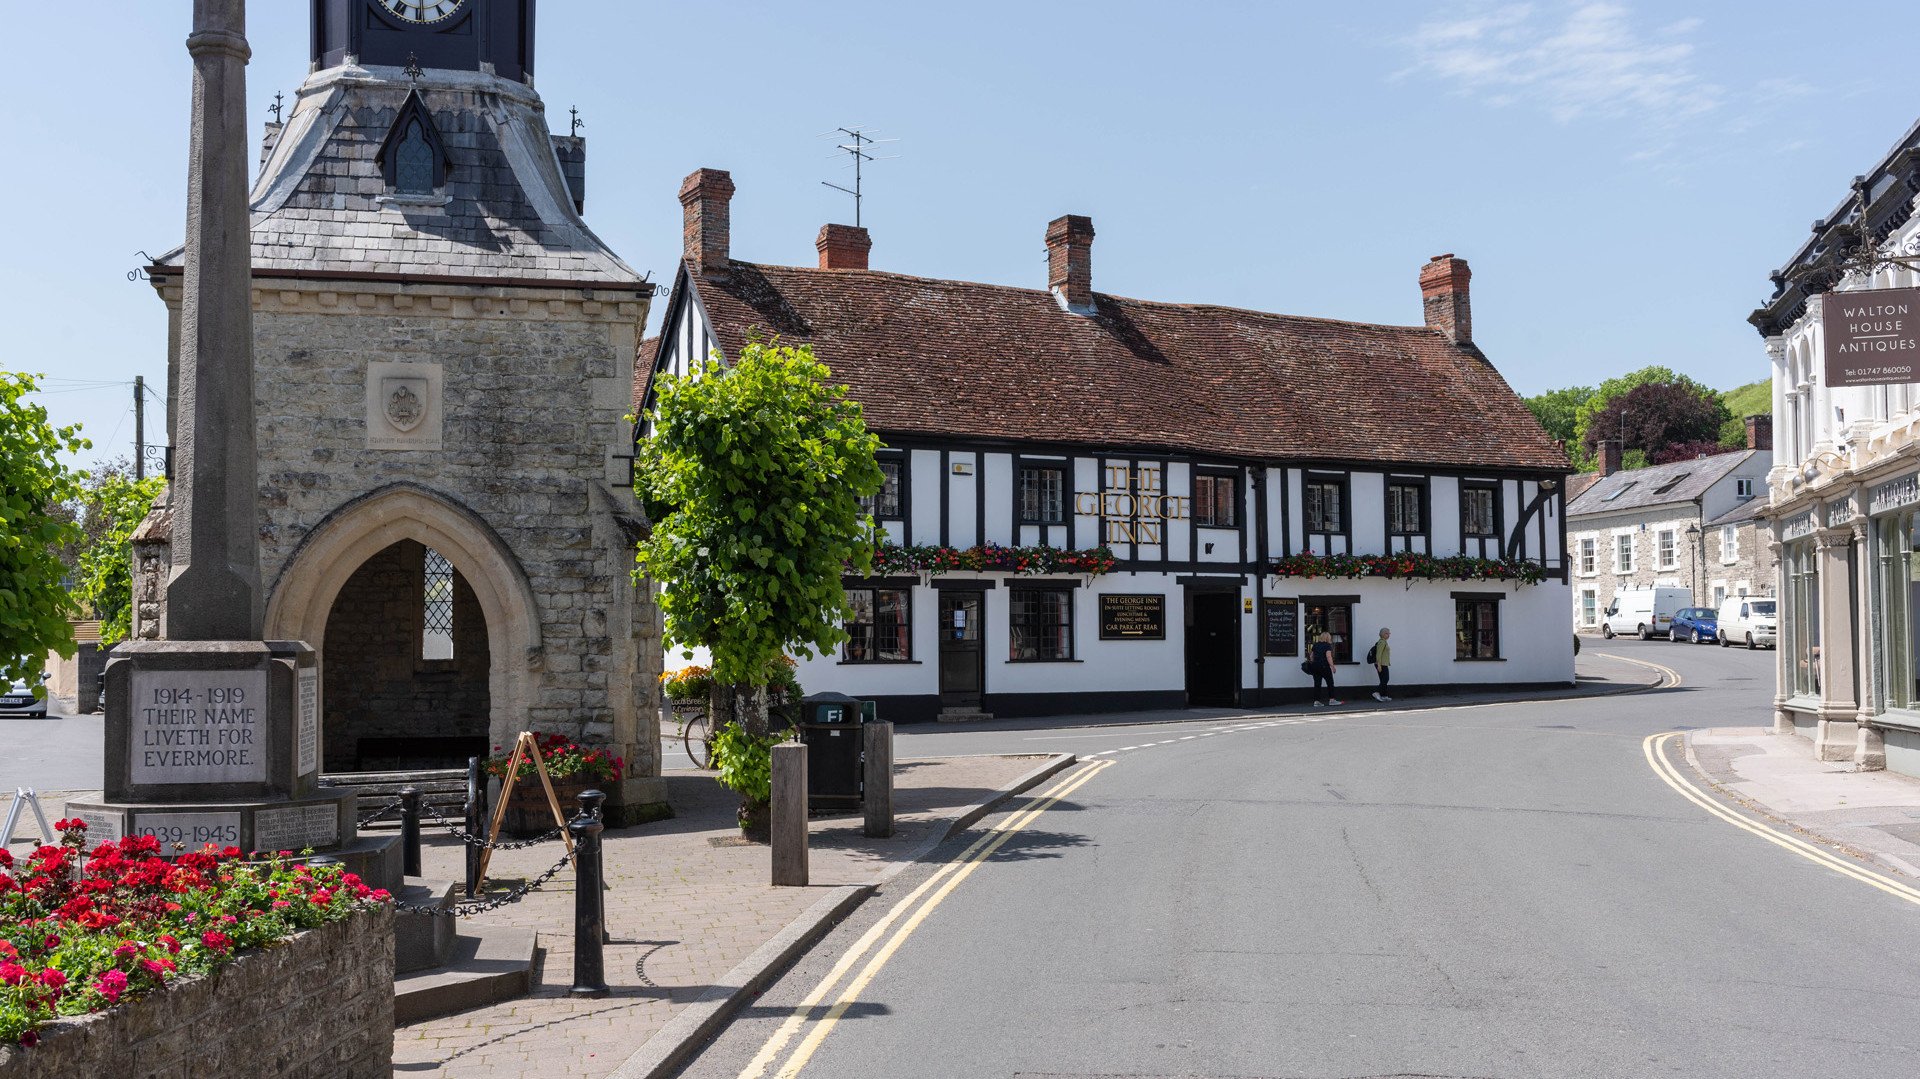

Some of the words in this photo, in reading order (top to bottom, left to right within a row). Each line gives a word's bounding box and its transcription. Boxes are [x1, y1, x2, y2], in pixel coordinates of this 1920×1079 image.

[1844, 305, 1908, 317] WALTON
[1850, 321, 1902, 333] HOUSE
[1839, 339, 1916, 353] ANTIQUES
[1857, 367, 1881, 376] 01747
[1882, 365, 1912, 374] 860050
[1106, 466, 1160, 492] THE
[1076, 492, 1190, 520] GEORGE
[1108, 520, 1159, 545] INN
[143, 708, 196, 725] THEIR
[204, 708, 255, 724] NAME
[144, 730, 210, 746] LIVETH
[218, 729, 253, 744] FOR
[144, 750, 254, 767] EVERMORE.
